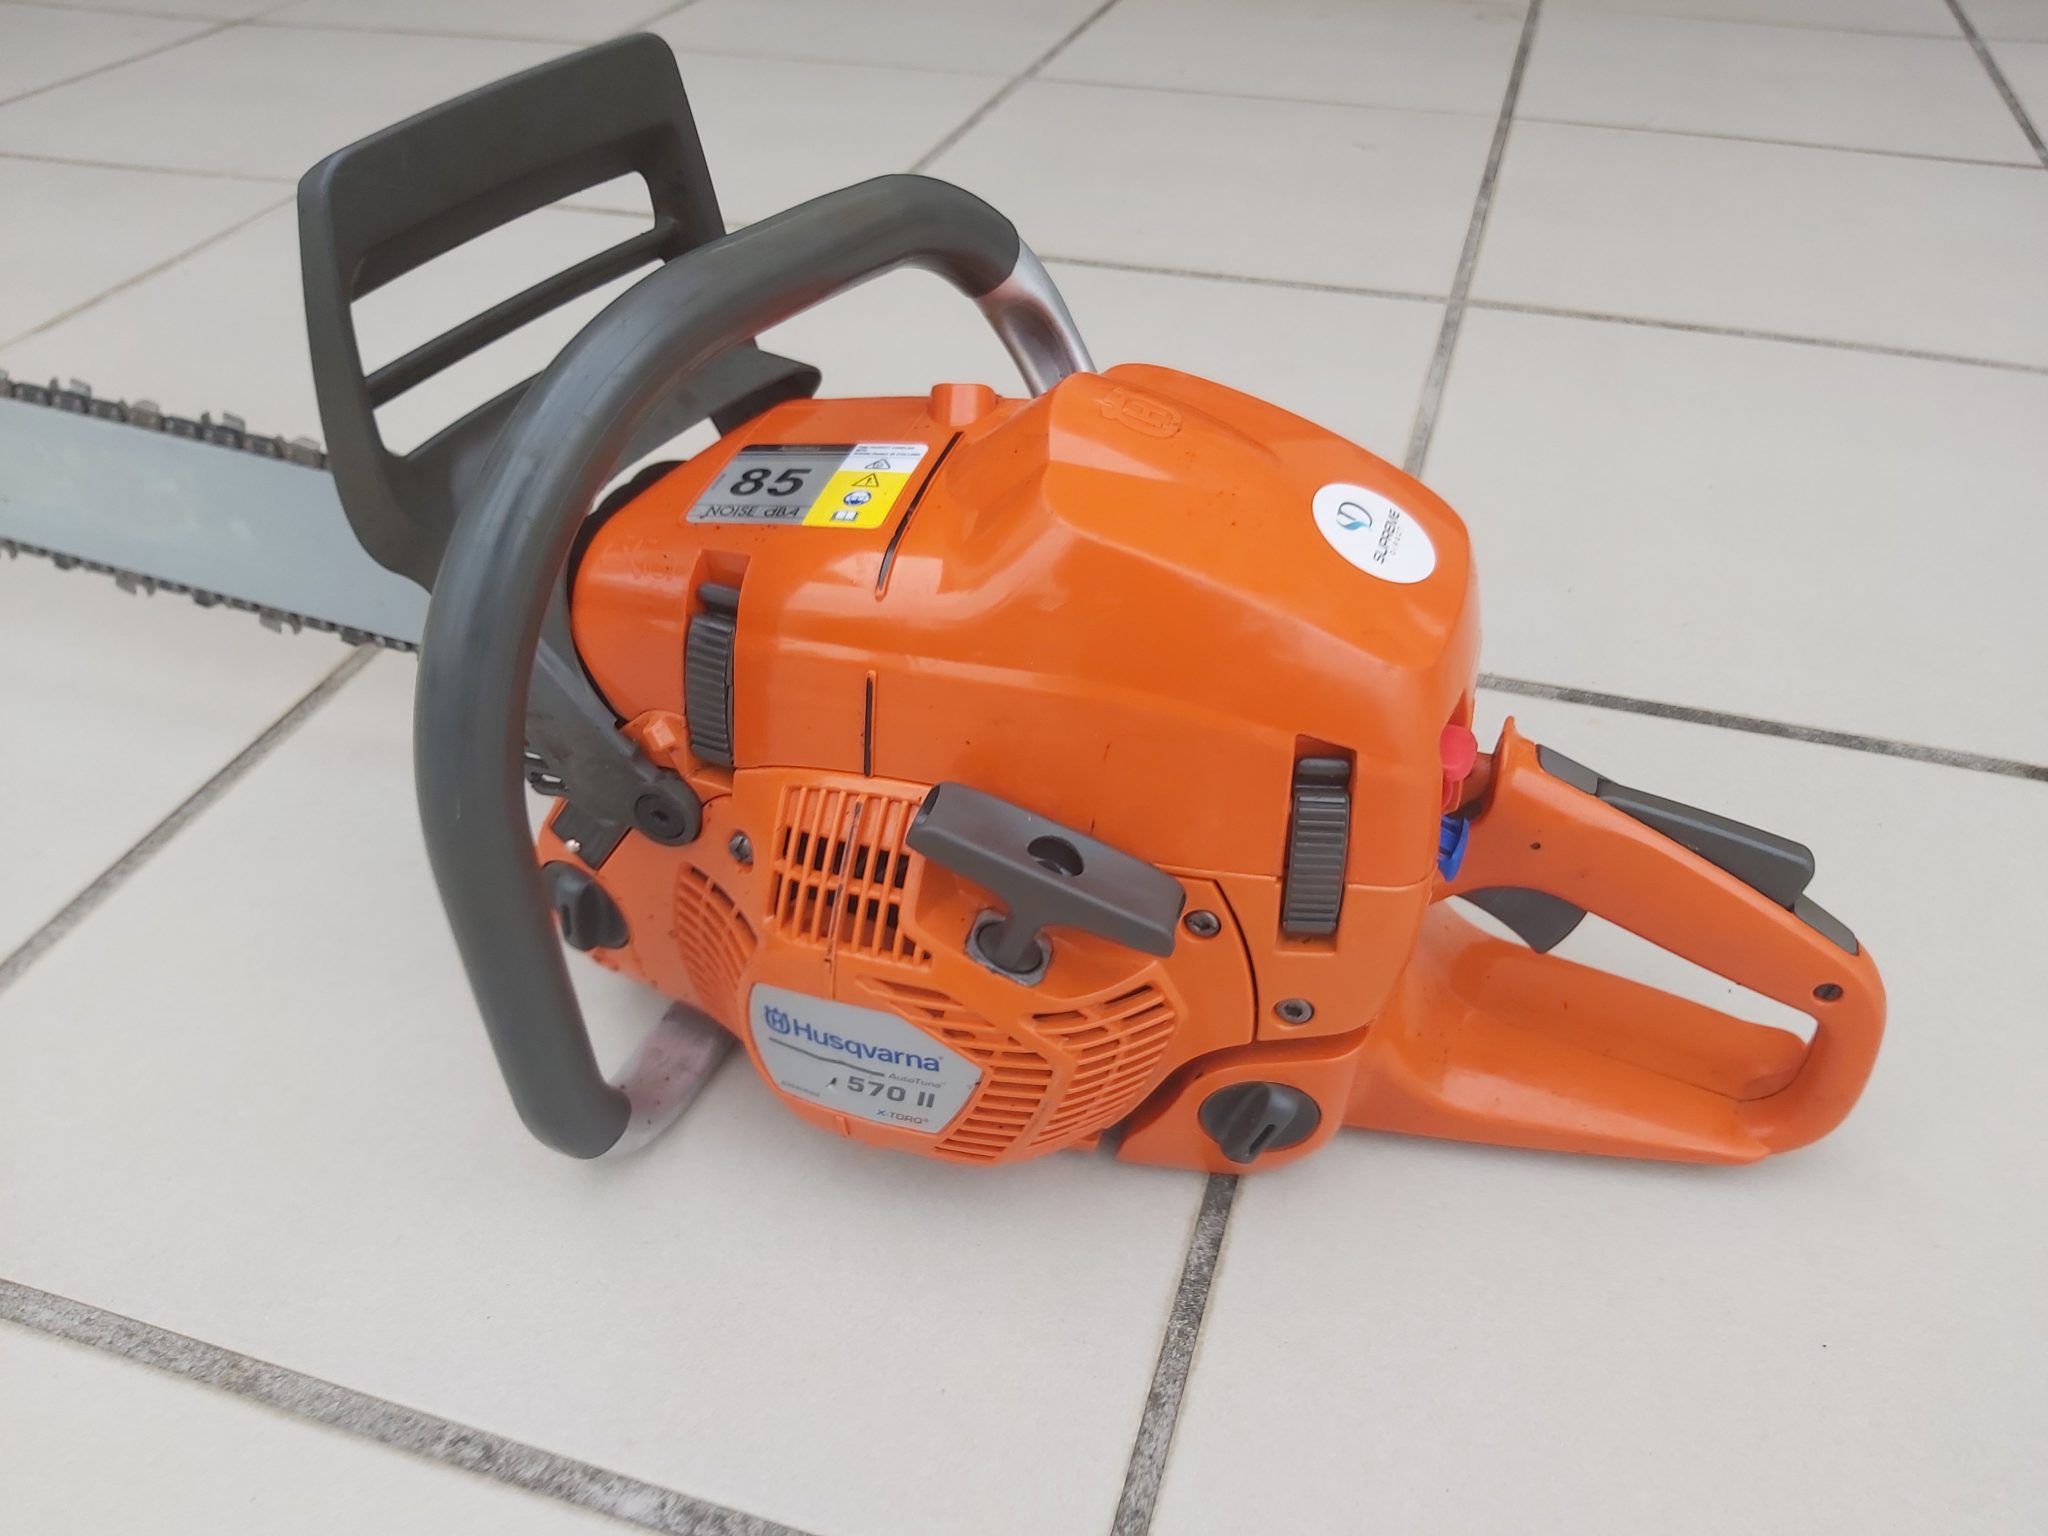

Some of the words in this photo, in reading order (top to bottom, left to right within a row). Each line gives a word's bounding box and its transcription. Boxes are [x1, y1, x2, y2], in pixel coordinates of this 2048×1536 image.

[730, 468, 812, 497] 85
[704, 505, 759, 518] NOISE
[793, 1019, 940, 1073] Husqvarna
[847, 1075, 906, 1102] 570
[917, 1091, 936, 1109] II
